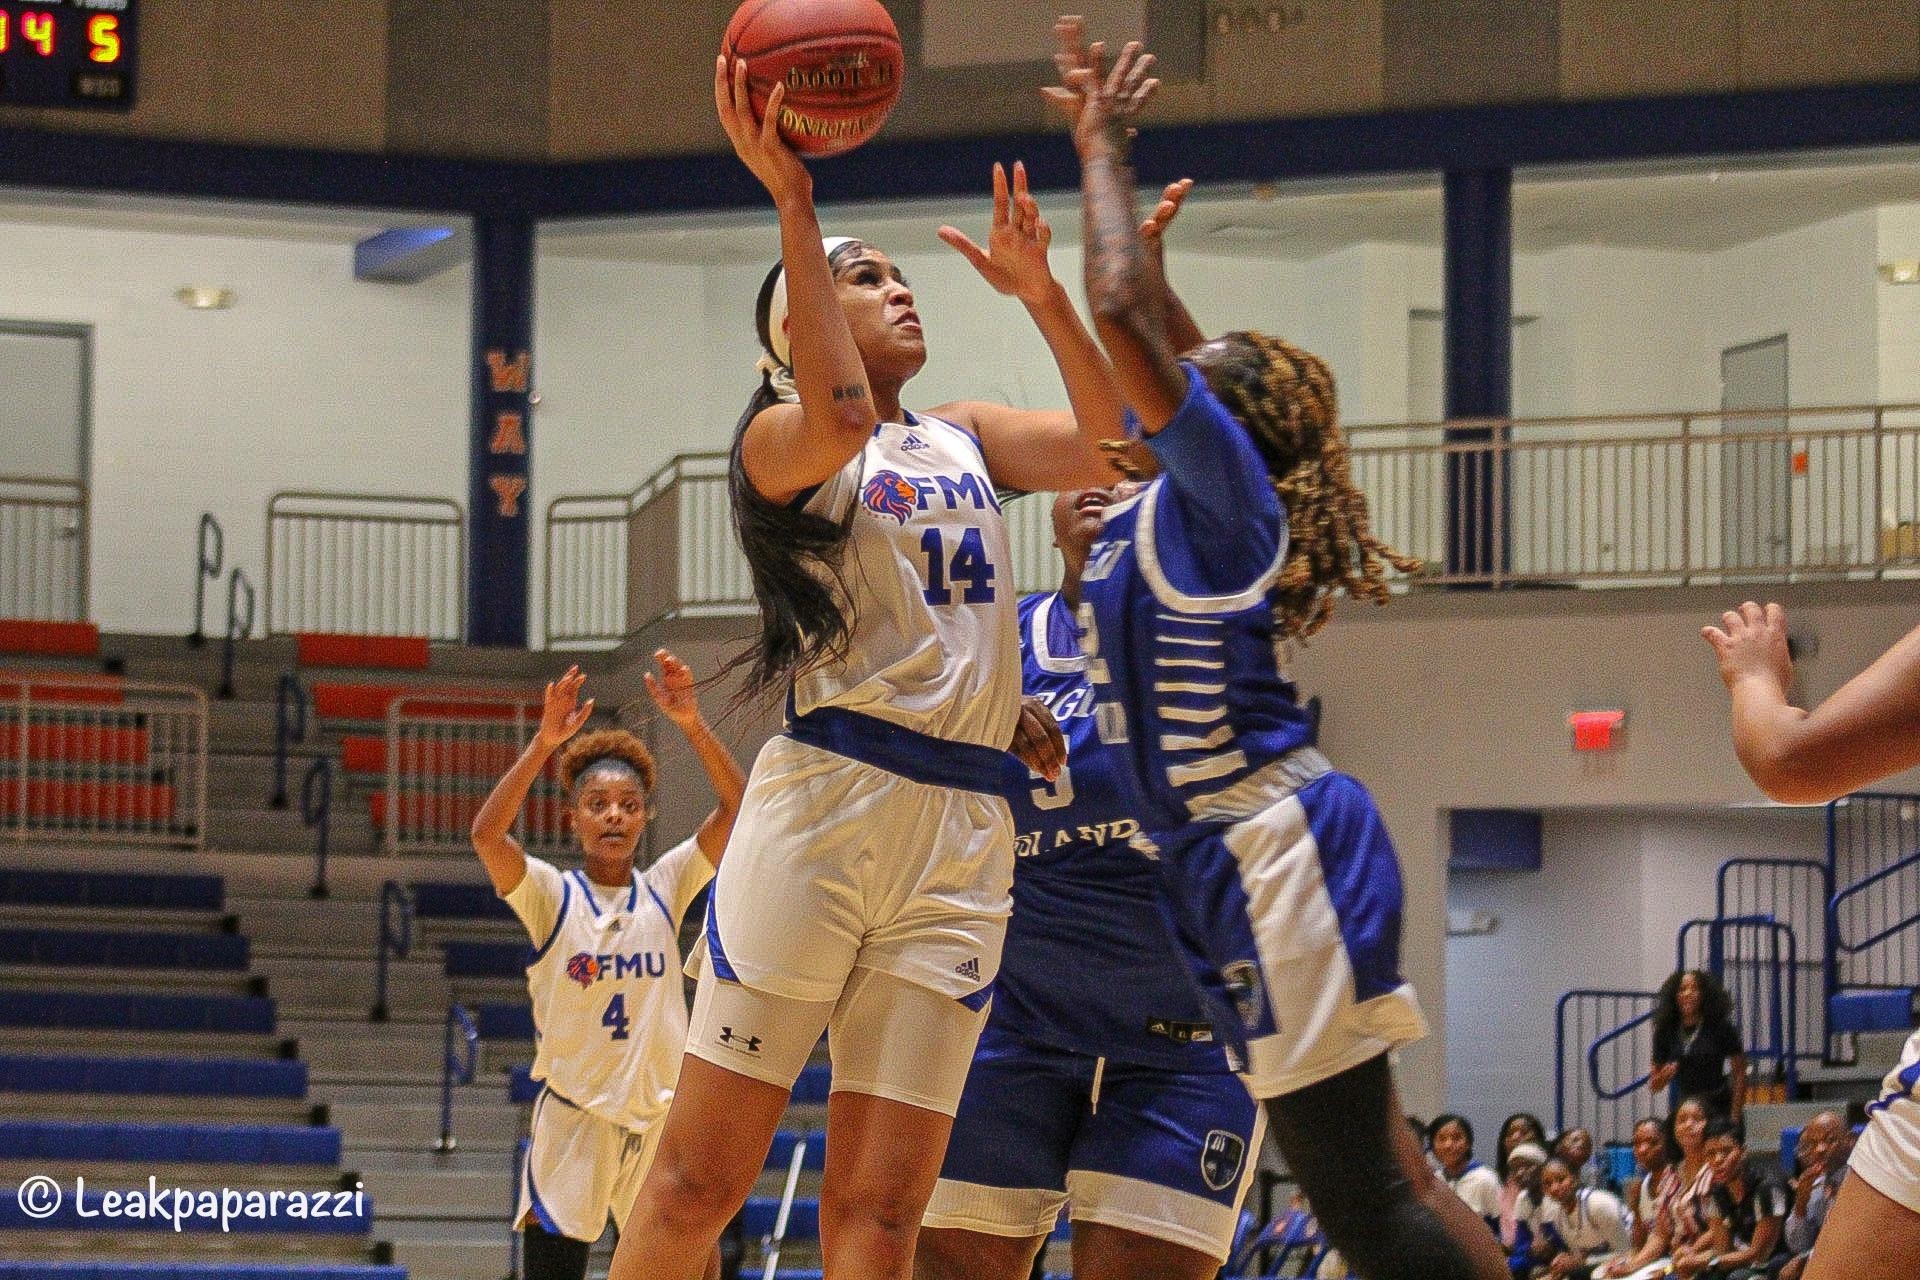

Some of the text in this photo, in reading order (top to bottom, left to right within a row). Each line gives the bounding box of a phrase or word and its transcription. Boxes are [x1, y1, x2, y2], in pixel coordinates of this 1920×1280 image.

[87, 13, 121, 63] 5
[486, 348, 531, 518] WAY
[920, 528, 995, 606] 14
[596, 952, 665, 981] FMU
[602, 993, 630, 1041] 4
